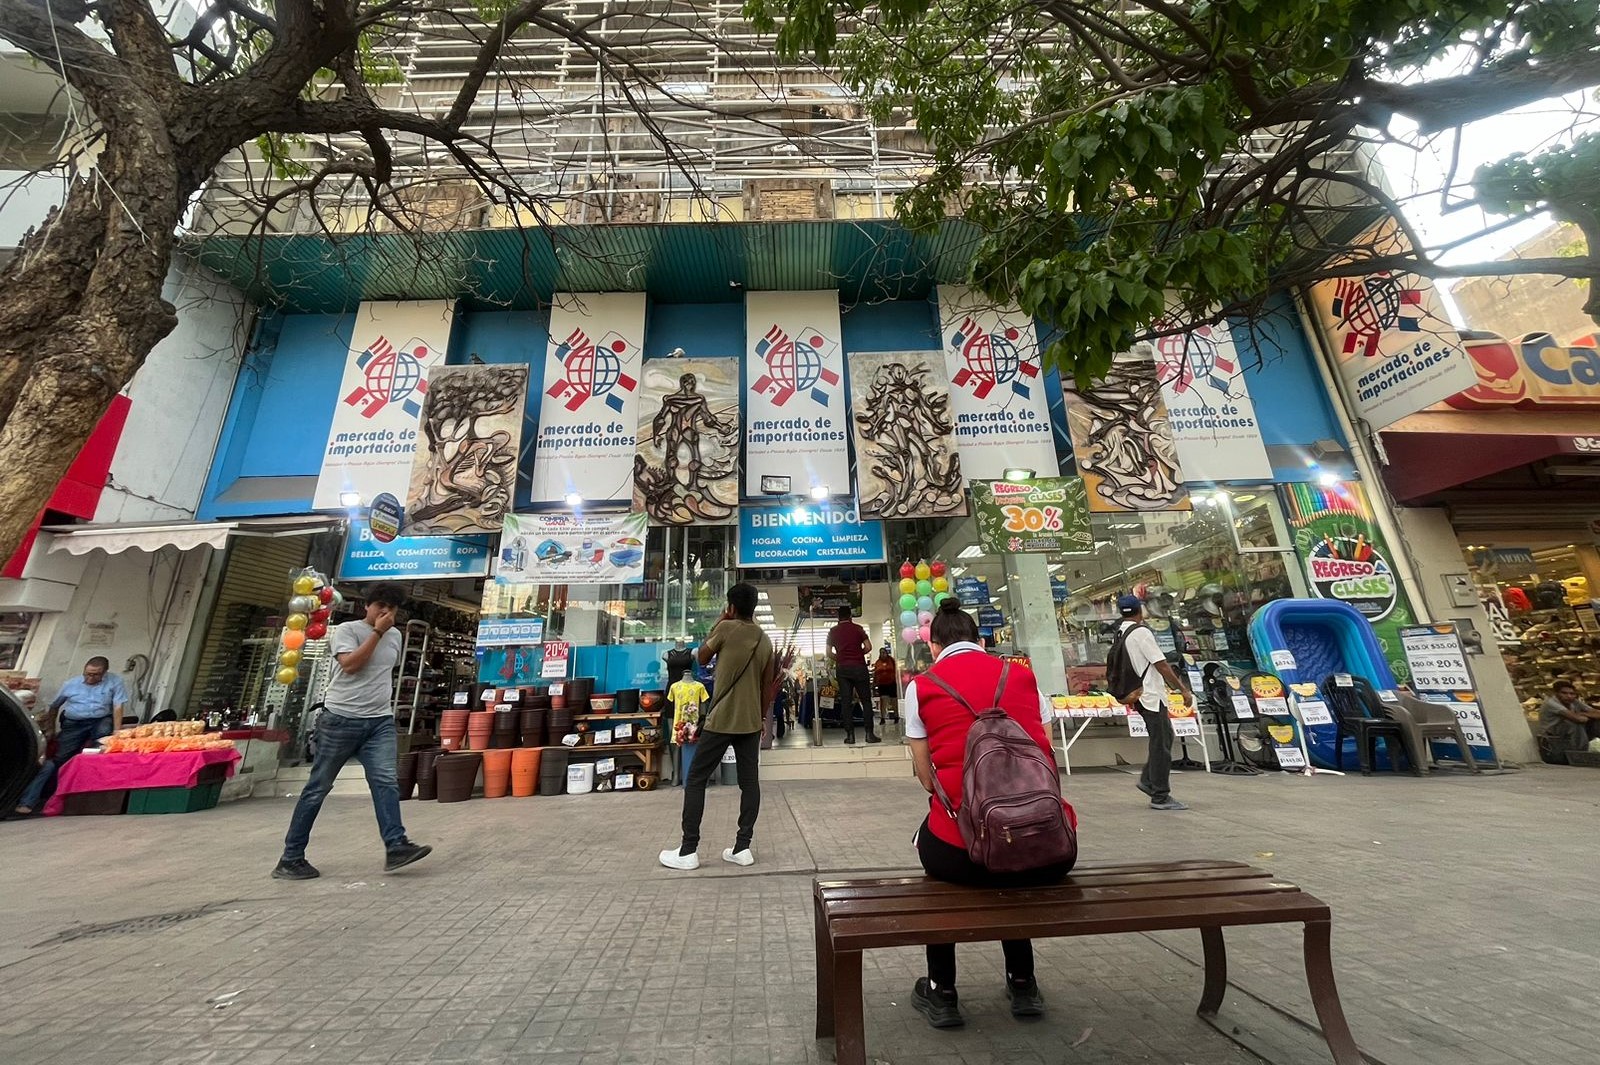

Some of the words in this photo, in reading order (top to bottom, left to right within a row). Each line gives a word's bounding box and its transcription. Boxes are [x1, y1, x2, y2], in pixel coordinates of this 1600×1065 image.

[1357, 354, 1409, 388] mercado
[1413, 341, 1431, 357] de
[1357, 347, 1450, 402] importaciones
[958, 409, 1014, 423] mercado
[1018, 408, 1035, 420] de
[1221, 404, 1238, 415] de
[544, 422, 602, 435] mercado
[606, 421, 623, 434] de
[753, 417, 810, 430] mercado
[815, 416, 831, 429] de
[954, 420, 1049, 438] importaciones
[1170, 415, 1254, 432] portaciones
[336, 429, 394, 442] mercado
[399, 428, 416, 440] de
[538, 433, 635, 451] importaciones
[748, 428, 845, 445] importaciones
[328, 440, 417, 457] importacione
[993, 483, 1031, 494] REGRESO
[1030, 489, 1064, 501] CLASES
[1006, 507, 1060, 530] 30%
[792, 536, 823, 544] COCINA
[832, 534, 869, 543] LIMPIEZA
[351, 550, 385, 558] BELLEZA
[456, 547, 478, 555] ROPA
[755, 547, 808, 558] DECORACIÓN
[817, 547, 867, 556] CRISTALERÍA
[367, 561, 419, 571] ACCESORIOS
[433, 560, 462, 568] TINTES
[1312, 560, 1373, 578] REGRESO
[1375, 562, 1388, 573] A
[1333, 577, 1390, 596] CLASES
[545, 643, 569, 657] 20%
[1436, 660, 1451, 668] 20
[1441, 677, 1456, 685] 20
[1254, 686, 1279, 695] OFERTA
[1168, 706, 1188, 714] OFERT
[1470, 710, 1481, 720] %
[1476, 732, 1487, 742] %
